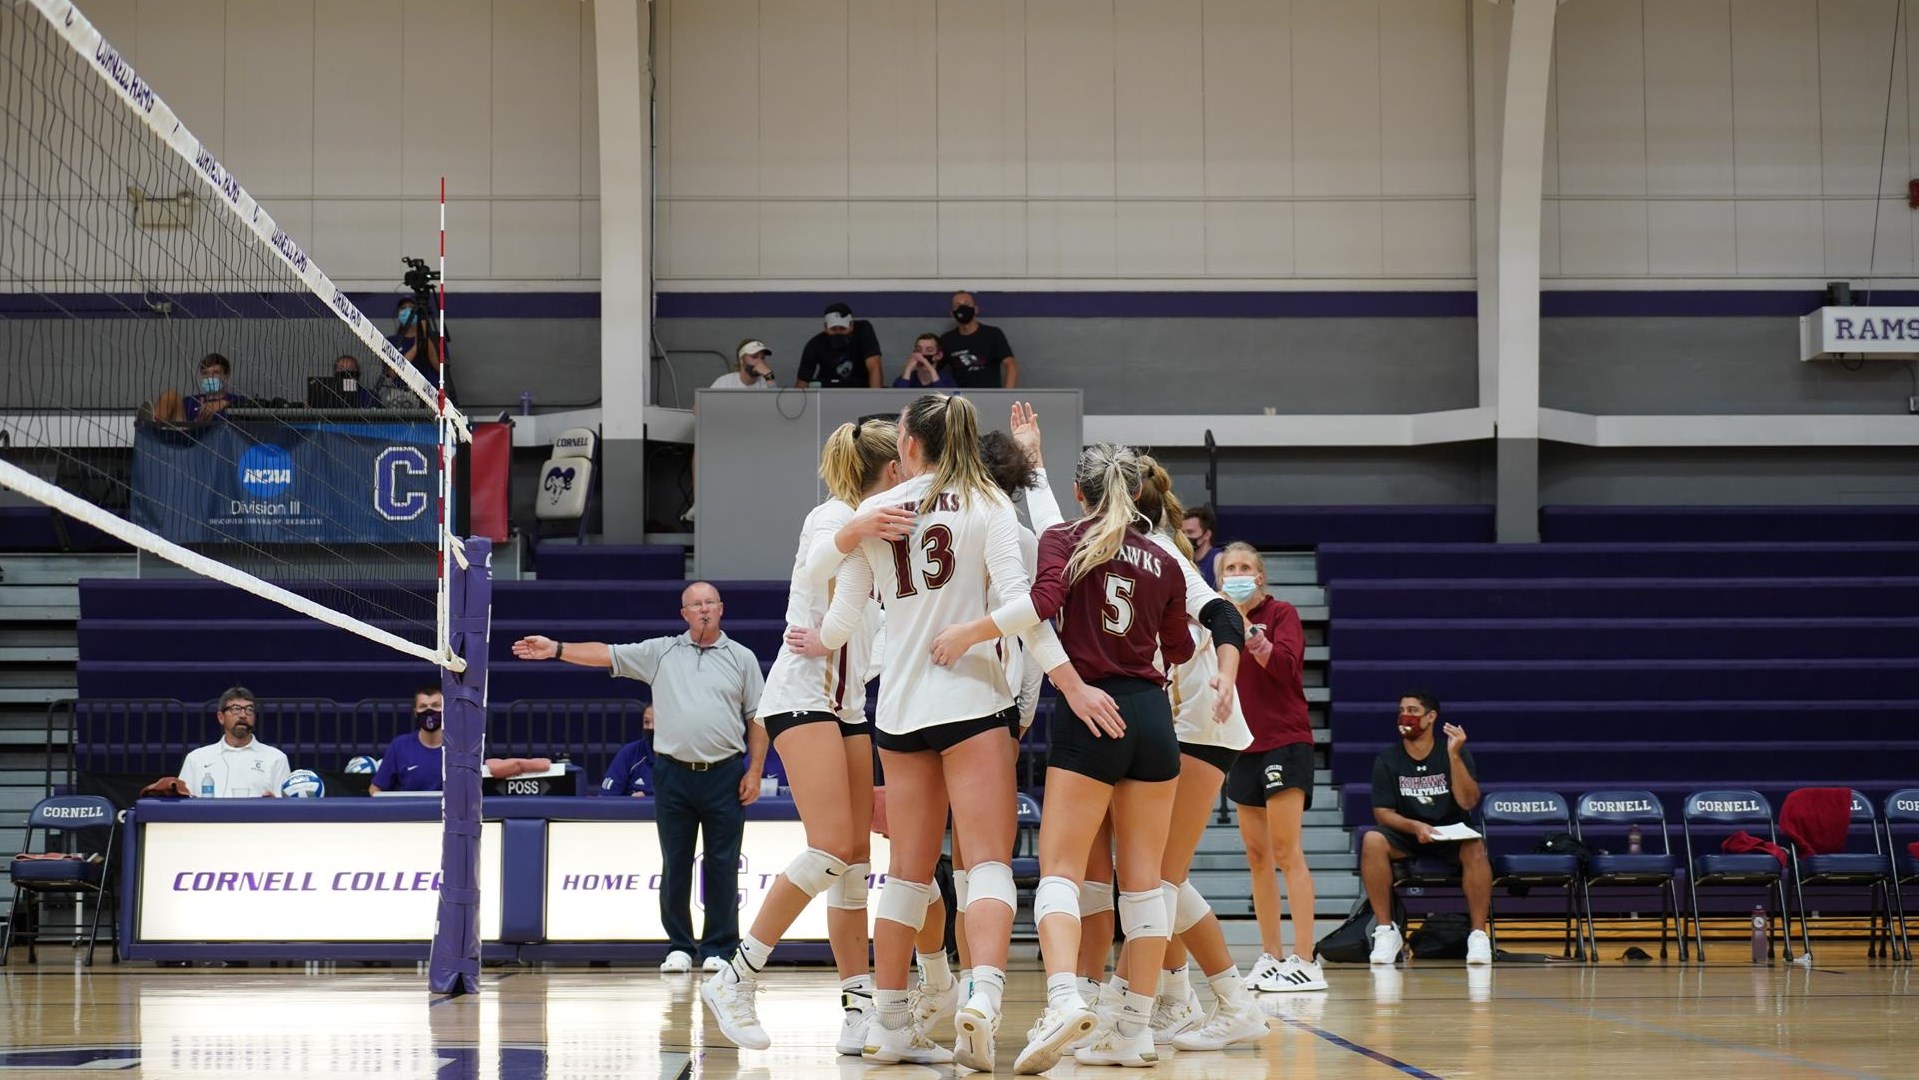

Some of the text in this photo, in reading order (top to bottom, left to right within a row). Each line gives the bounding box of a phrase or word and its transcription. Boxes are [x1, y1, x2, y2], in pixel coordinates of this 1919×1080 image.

[1835, 318, 1919, 340] RAMS
[556, 437, 589, 447] CORNELL
[374, 446, 428, 521] C
[231, 501, 300, 515] Division III
[881, 523, 956, 599] 13
[1101, 572, 1136, 636] 5
[508, 781, 539, 794] POSS
[1400, 785, 1449, 797] VOLLEYBALL
[43, 806, 104, 818] CORNELL
[1494, 801, 1557, 813] CORNELL
[1589, 800, 1652, 812] CORNELL
[1696, 800, 1759, 812] CORNELL
[173, 872, 441, 891] CORNELL COLLE
[562, 874, 640, 890] HOME
